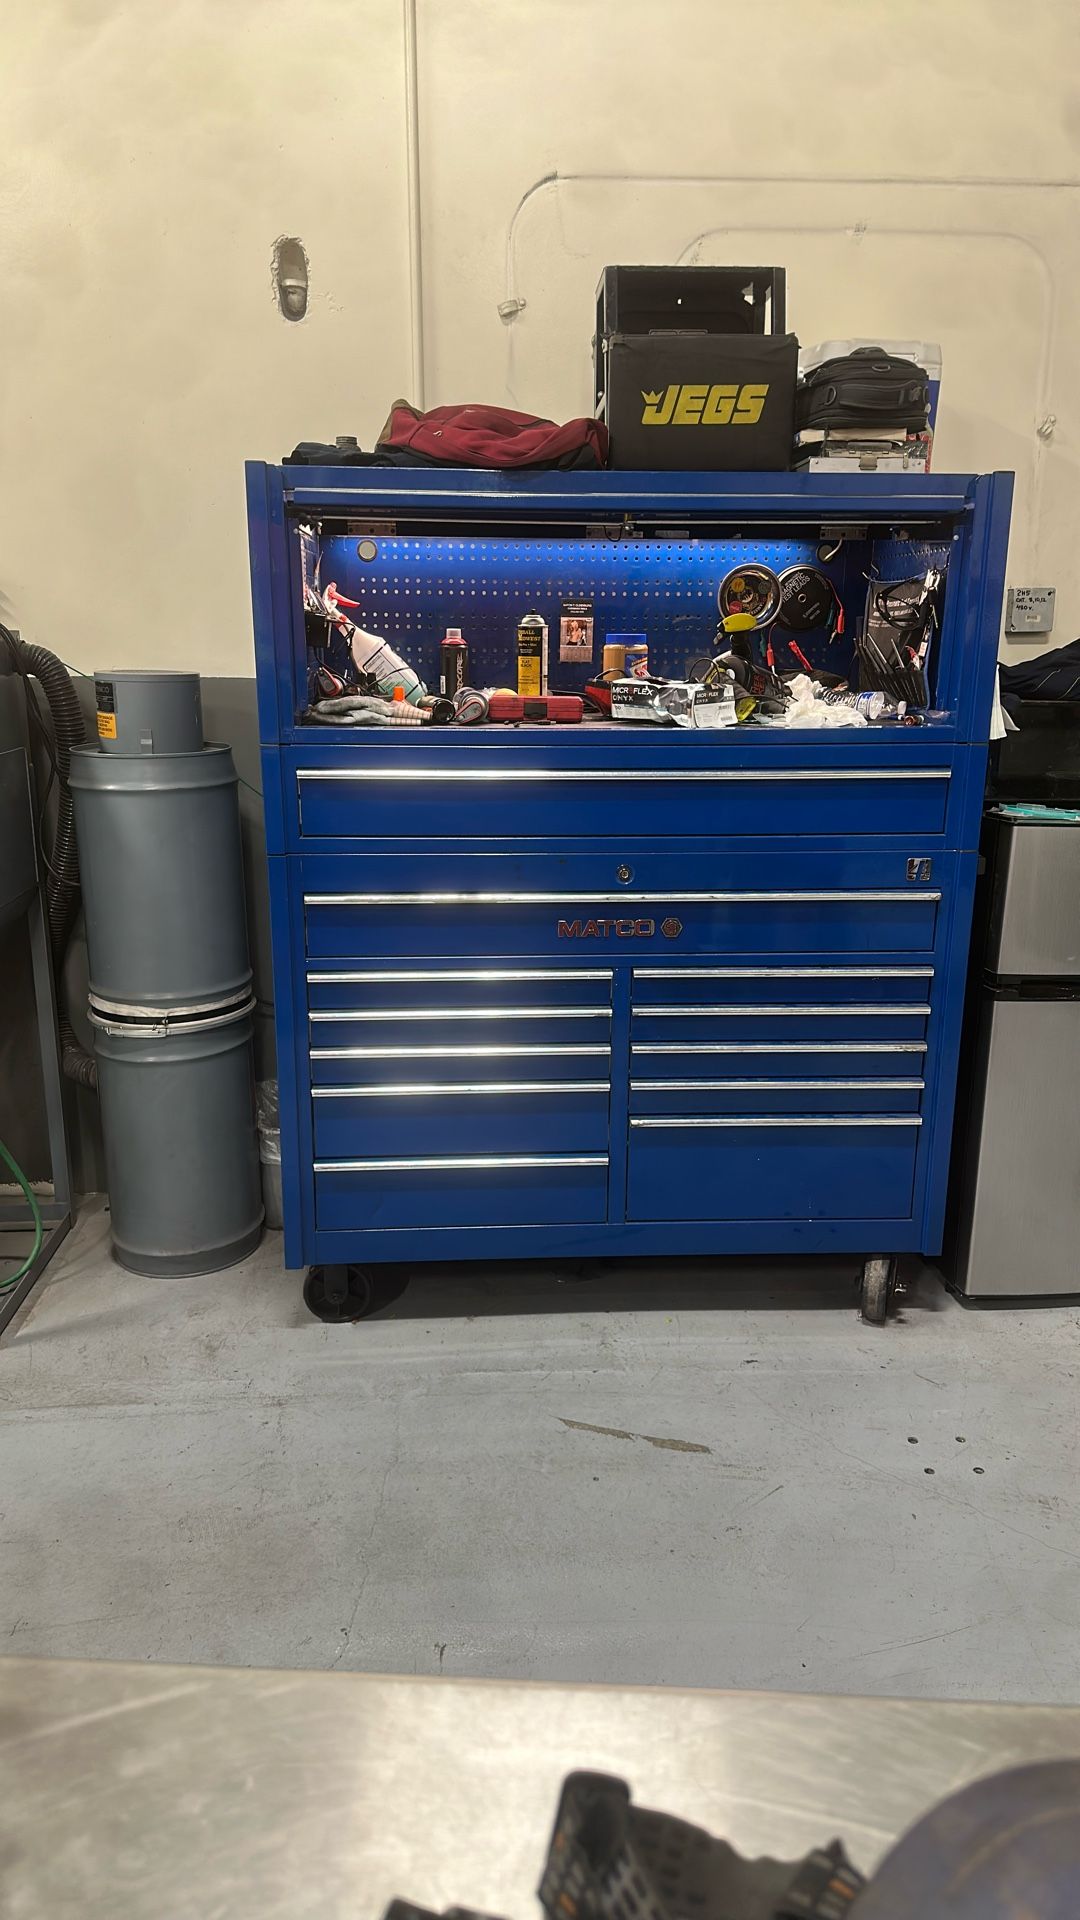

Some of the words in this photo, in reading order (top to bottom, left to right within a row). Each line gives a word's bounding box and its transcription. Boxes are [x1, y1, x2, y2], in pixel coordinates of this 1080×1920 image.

[641, 384, 770, 425] JEGS
[781, 572, 805, 595] AGNETIC
[793, 575, 811, 592] LEADS
[558, 919, 655, 938] MATCO
